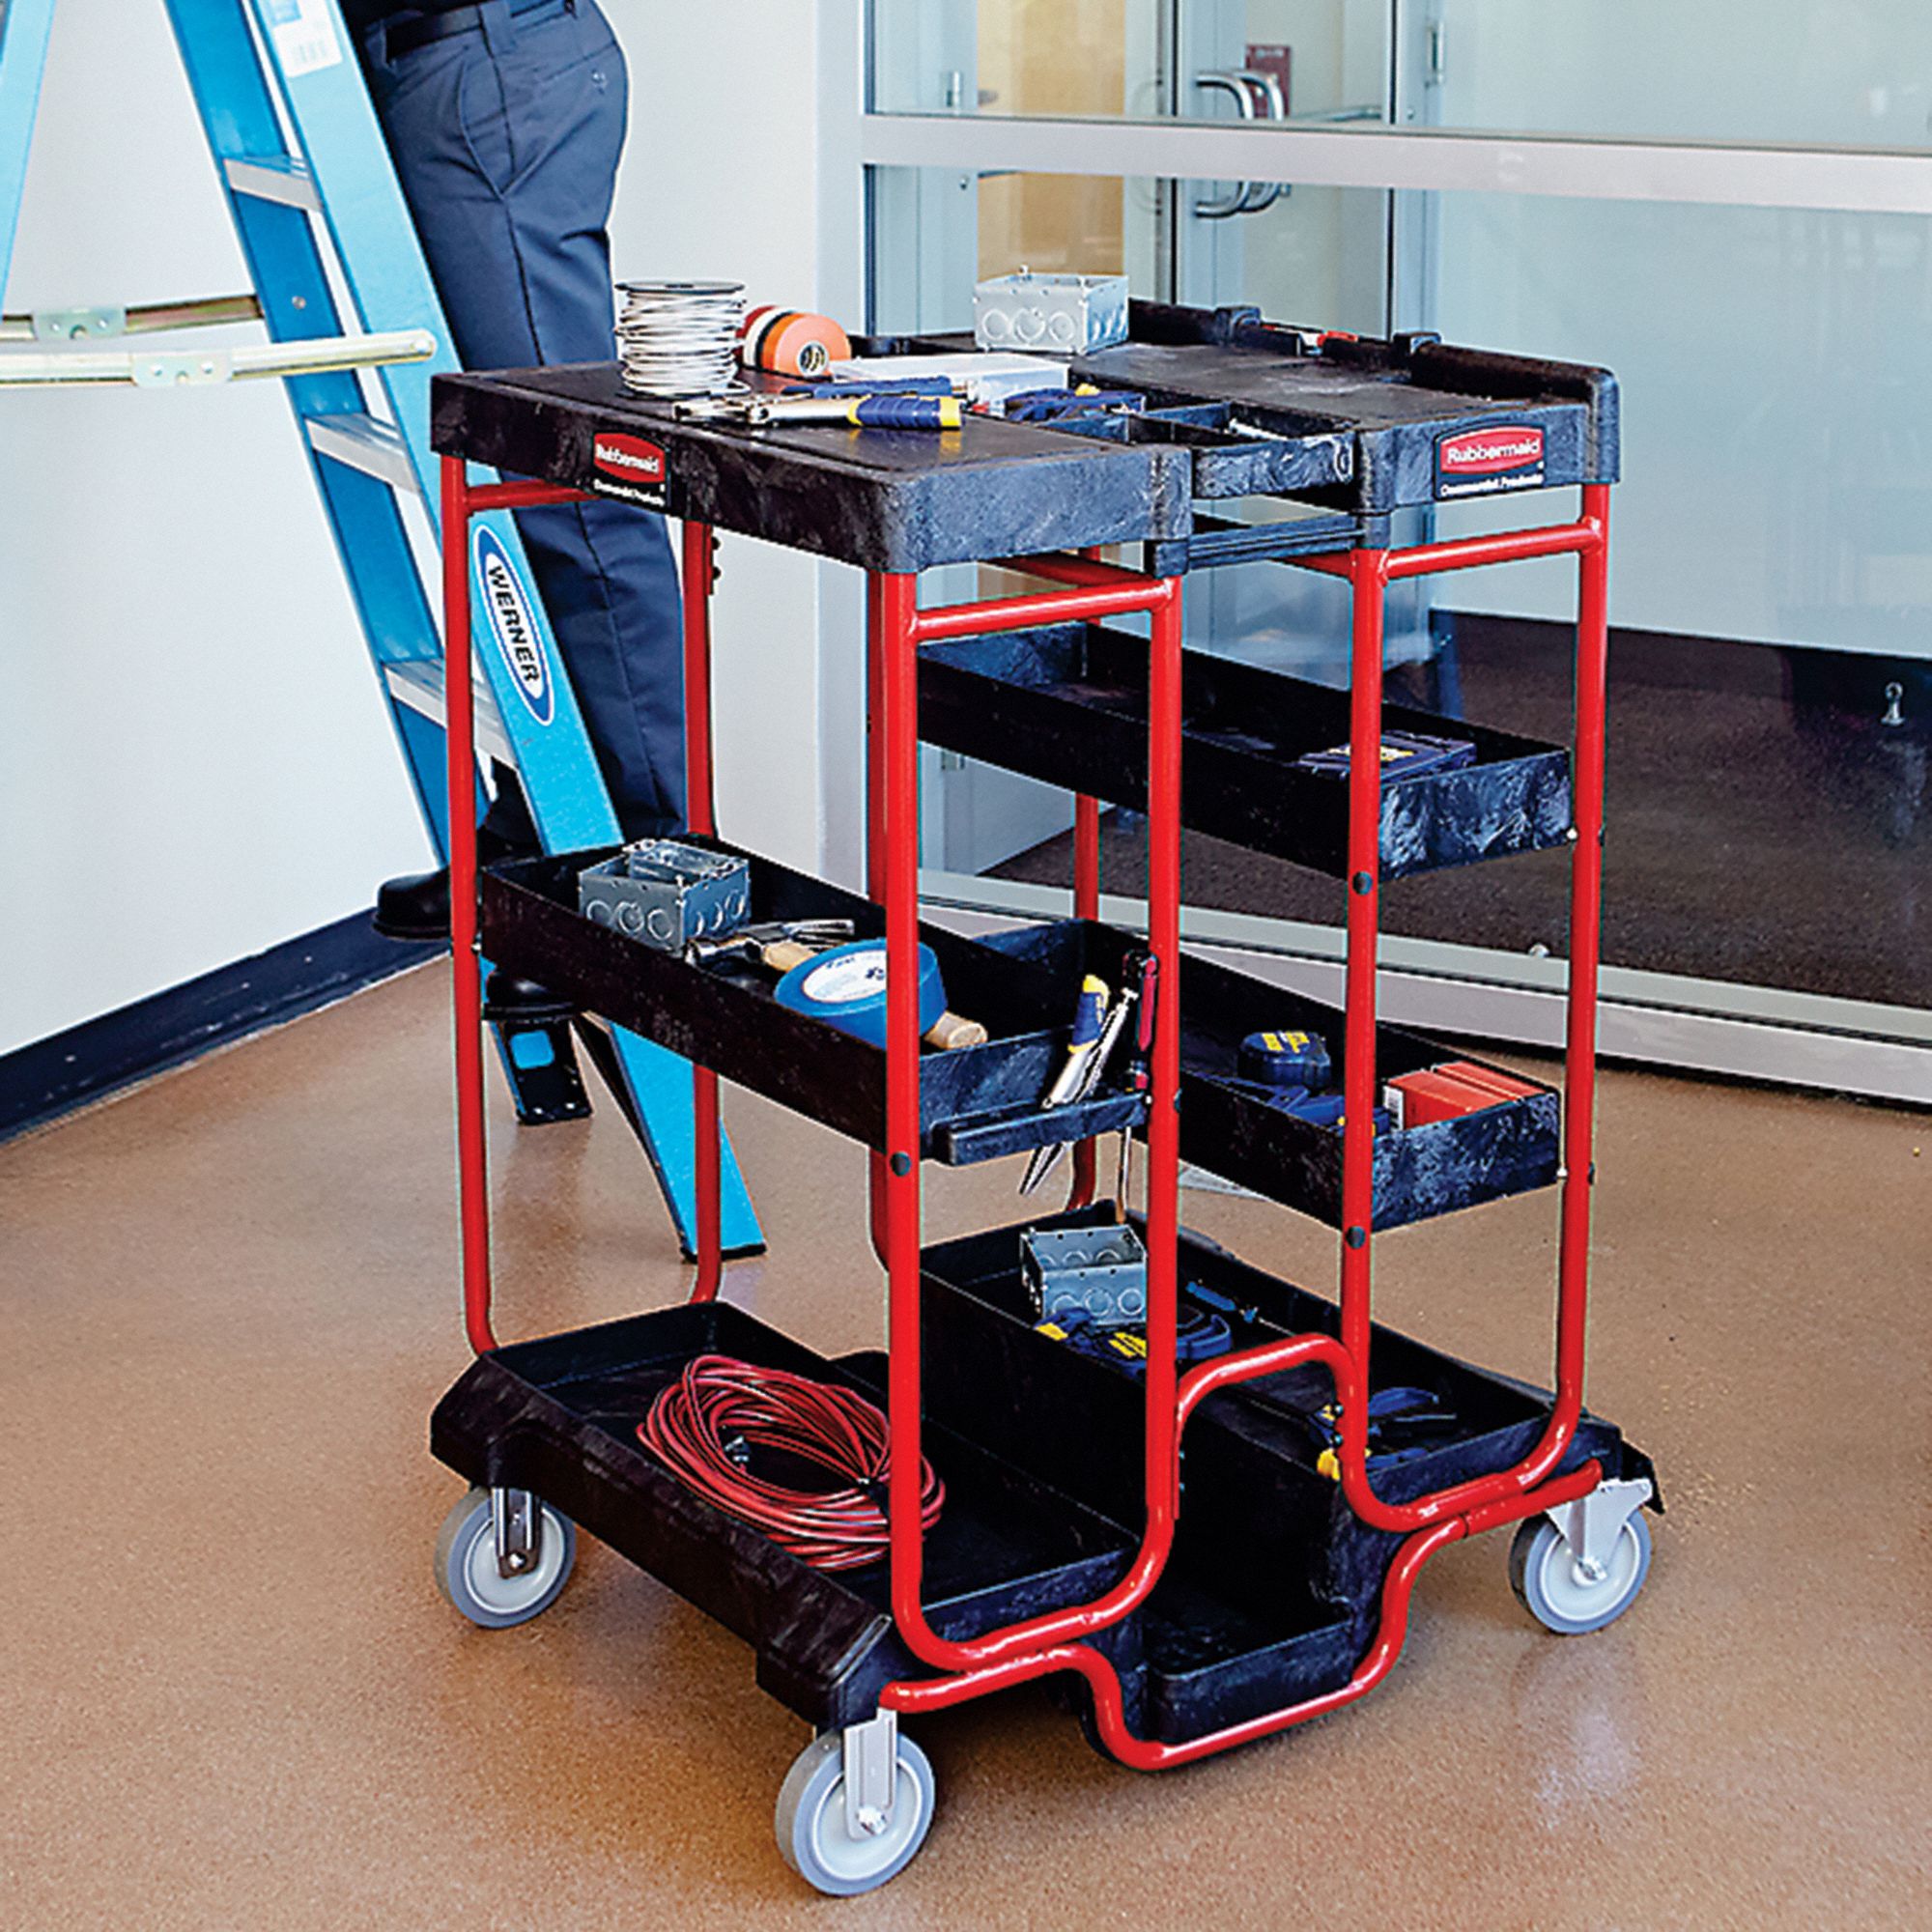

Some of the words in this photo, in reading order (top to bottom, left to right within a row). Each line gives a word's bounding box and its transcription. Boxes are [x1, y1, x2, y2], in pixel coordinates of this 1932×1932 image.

[595, 443, 659, 474] Rubbermaid
[1447, 439, 1541, 465] Rubbermaid
[488, 565, 541, 682] WERNER
